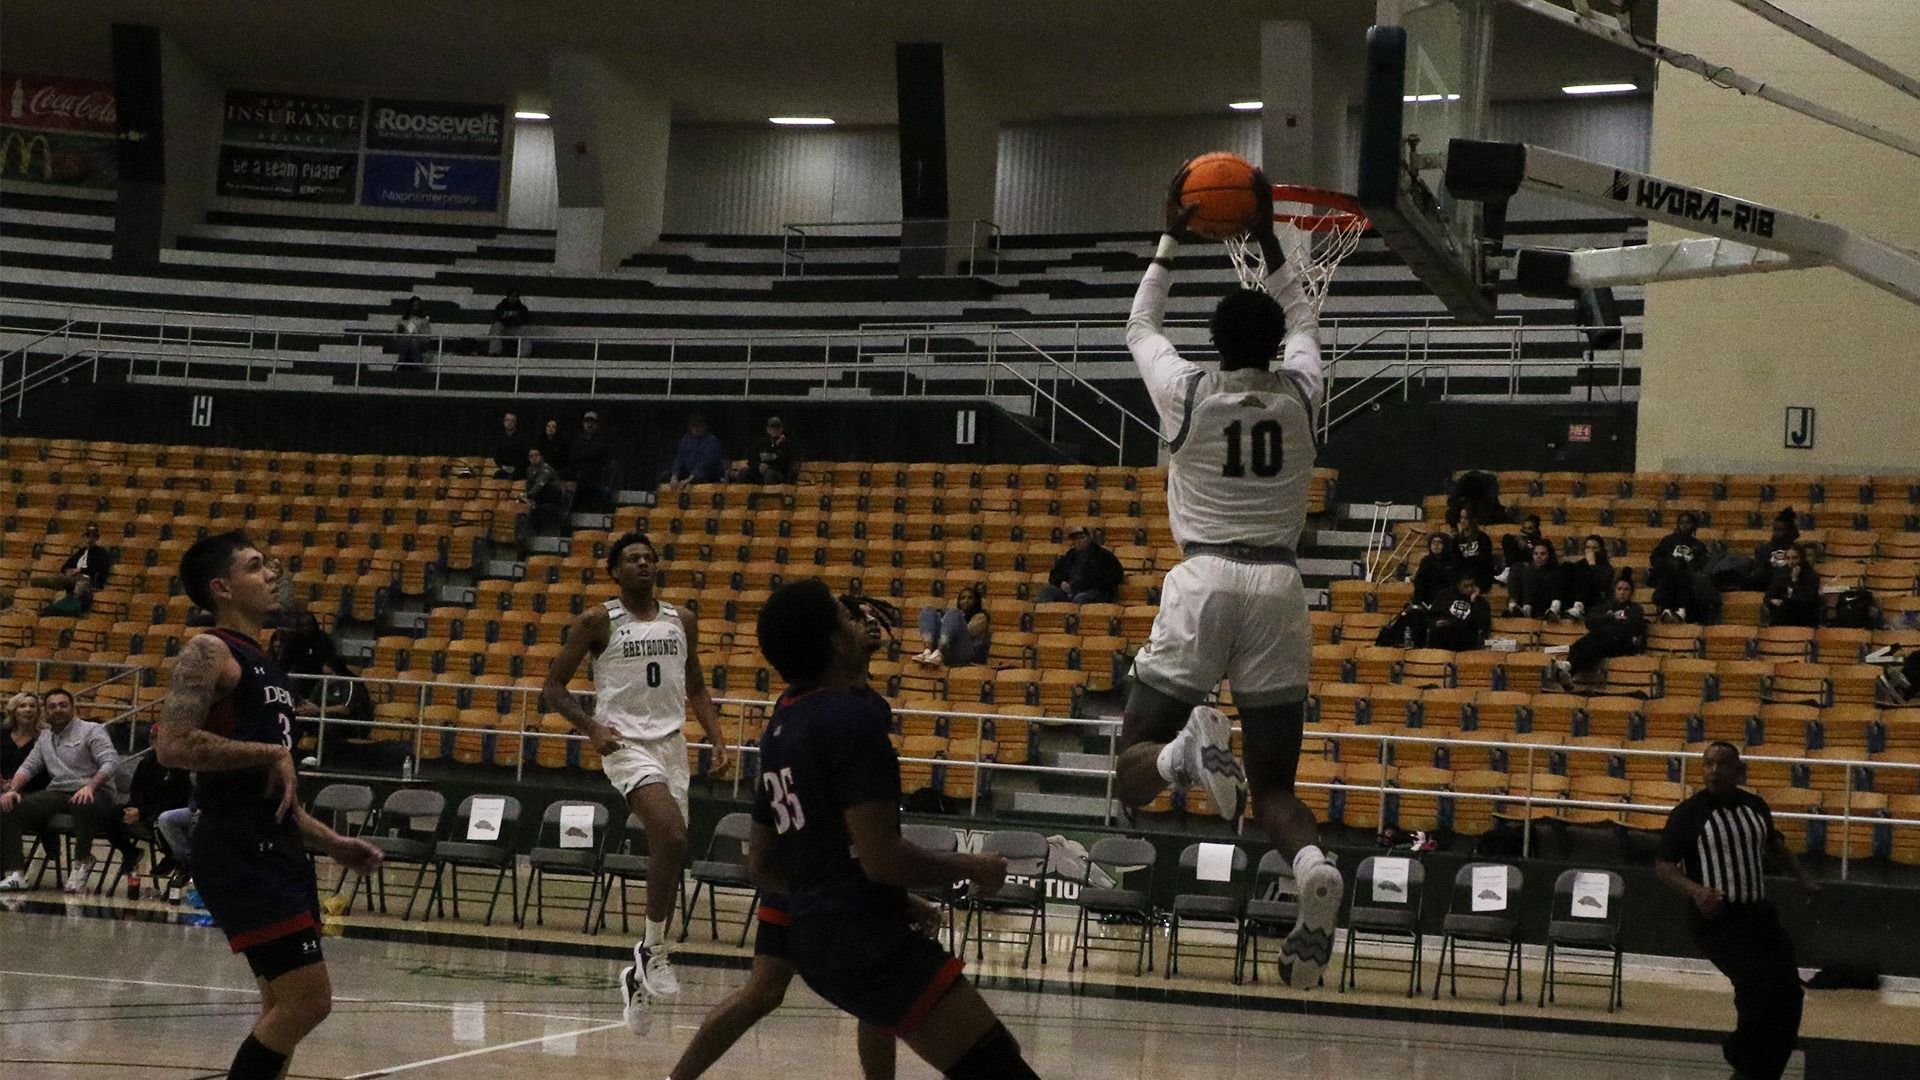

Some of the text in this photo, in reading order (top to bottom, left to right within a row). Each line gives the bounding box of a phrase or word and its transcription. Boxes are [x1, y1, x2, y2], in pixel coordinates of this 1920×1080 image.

[227, 105, 360, 130] INSURANCE
[378, 107, 500, 136] Roosevelt
[265, 161, 298, 177] team
[1636, 179, 1775, 238] HYDRA-RIB
[1791, 408, 1808, 445] J
[1222, 420, 1283, 477] 10
[623, 639, 679, 658] GREYHOUNDS
[646, 662, 661, 688] 0
[278, 712, 293, 751] 3
[763, 767, 806, 835] 35
